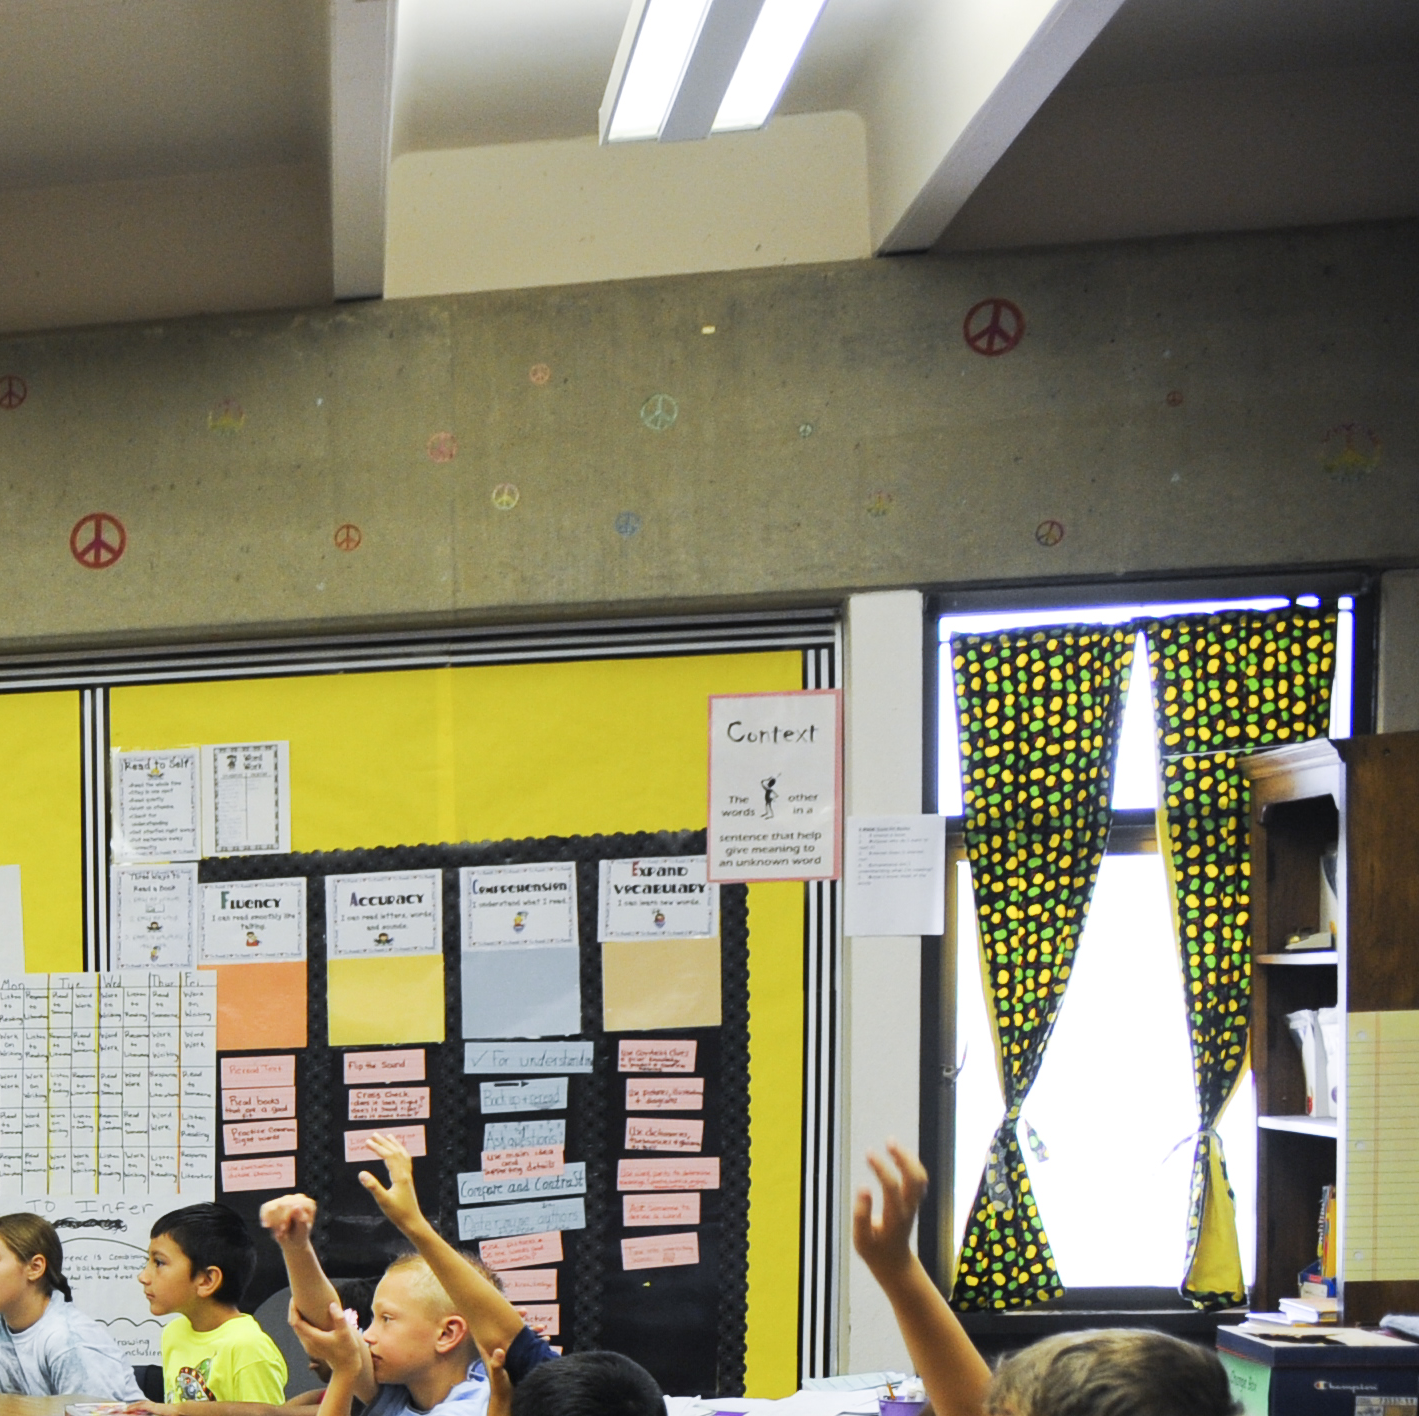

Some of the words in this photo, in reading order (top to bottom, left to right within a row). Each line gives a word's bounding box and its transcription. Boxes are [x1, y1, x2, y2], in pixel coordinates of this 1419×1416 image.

[727, 720, 818, 744] Context
[124, 759, 151, 771] Read
[155, 759, 165, 769] to
[169, 757, 189, 768] Self
[728, 795, 749, 804] The
[788, 793, 818, 802] other
[721, 807, 755, 817] words
[793, 806, 804, 814] in
[720, 832, 769, 842] sentence
[771, 832, 794, 841] that
[797, 831, 822, 841] help
[725, 845, 748, 856] give
[751, 844, 800, 855] meaning
[803, 844, 815, 853] to
[719, 858, 733, 866] an
[736, 856, 789, 867] unknown
[792, 856, 822, 865] word
[232, 913, 248, 921] read
[1, 979, 25, 989] Mon
[492, 1050, 510, 1066] For
[382, 1060, 406, 1069] Sound
[230, 1095, 252, 1106] Read
[257, 1097, 280, 1105] books
[461, 1181, 503, 1200] Compare
[508, 1181, 529, 1192] and
[535, 1171, 583, 1191] Contrast
[75, 1200, 153, 1215] Infer
[1314, 1381, 1378, 1393] Champion
